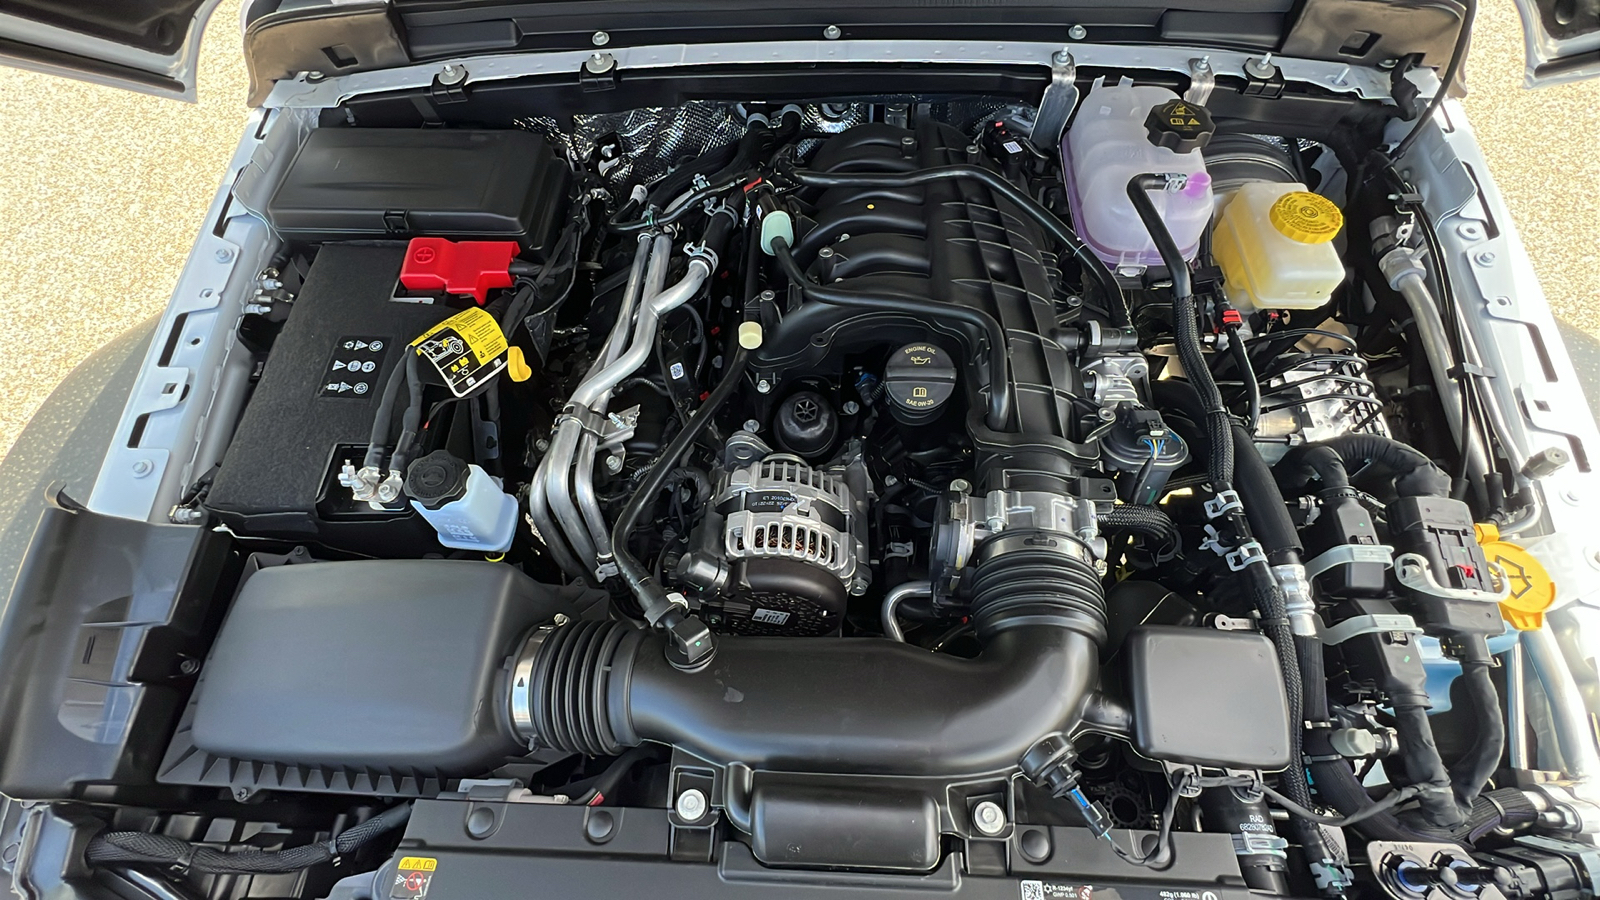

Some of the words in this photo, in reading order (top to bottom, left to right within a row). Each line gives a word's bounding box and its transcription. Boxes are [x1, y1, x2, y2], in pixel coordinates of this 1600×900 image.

[905, 346, 926, 354] ENGINE
[905, 398, 917, 406] SAE
[1249, 814, 1264, 823] RAD
